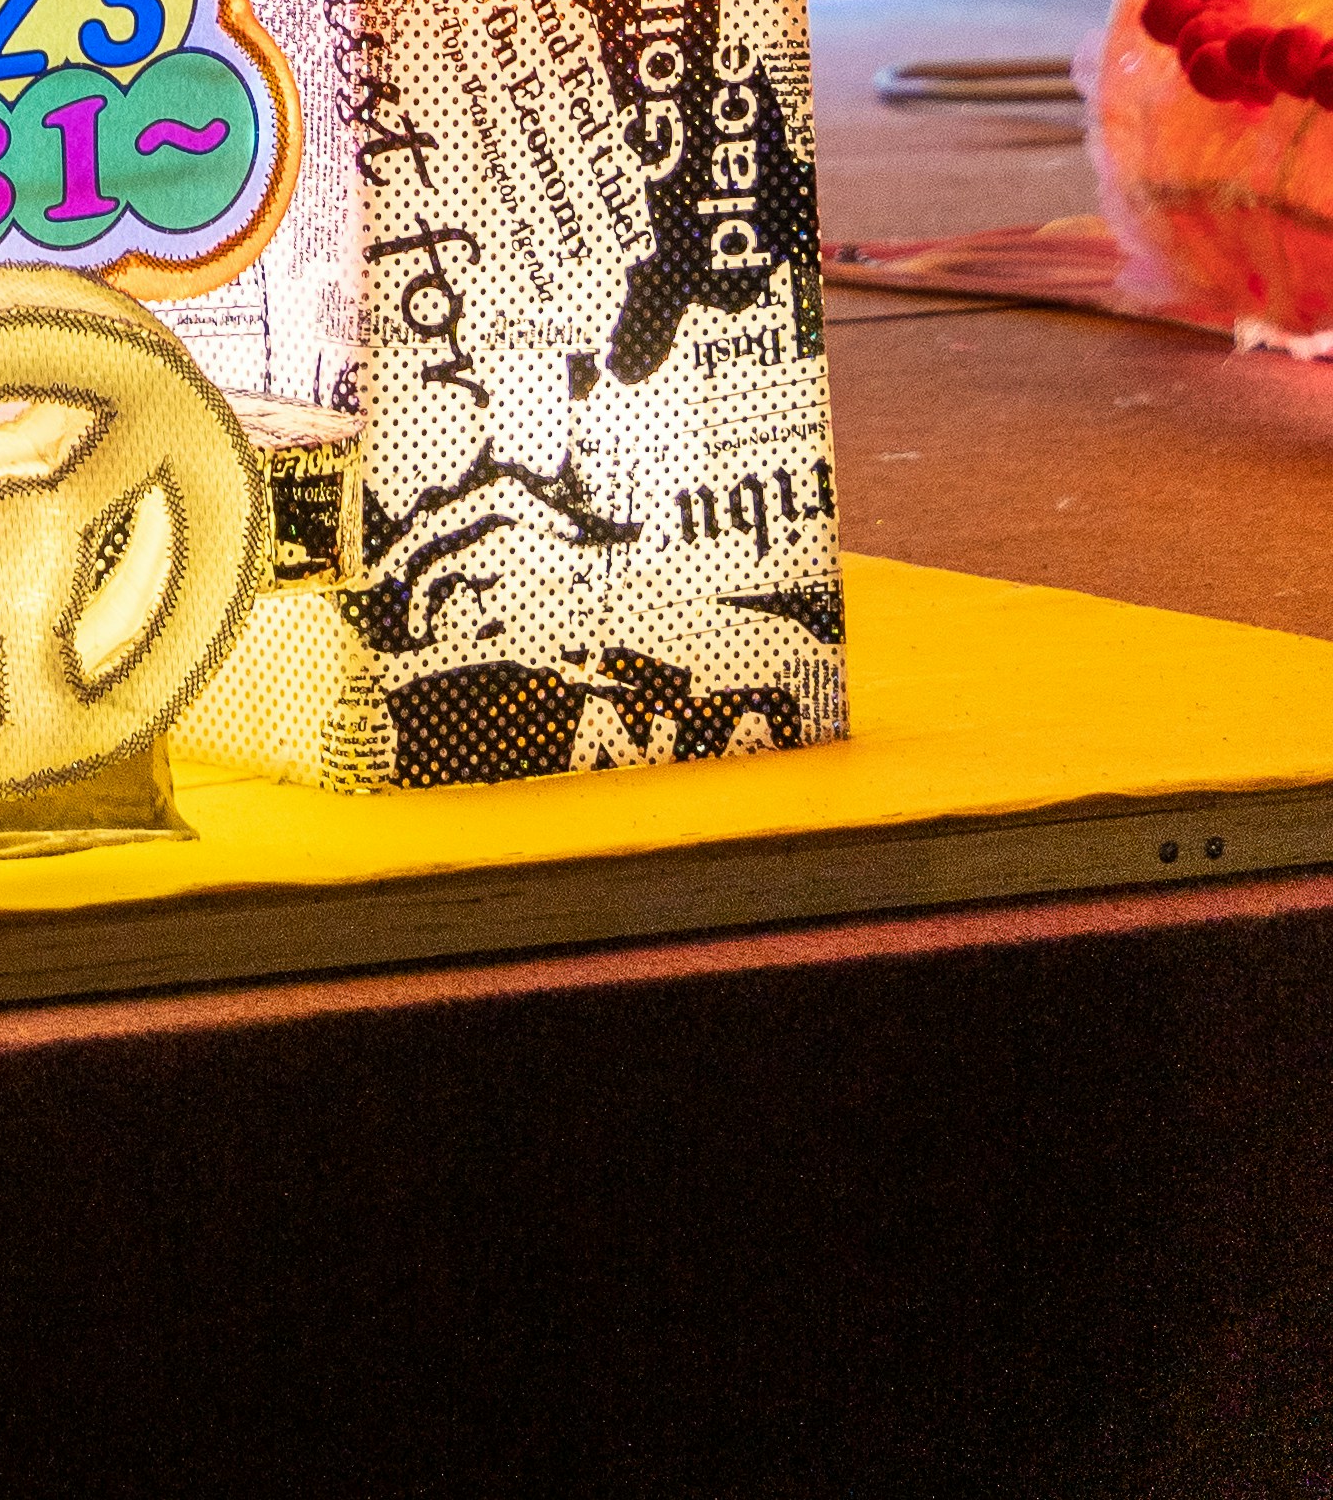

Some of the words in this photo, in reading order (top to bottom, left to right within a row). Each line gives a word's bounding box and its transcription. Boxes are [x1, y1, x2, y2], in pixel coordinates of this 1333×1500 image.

[440, 16, 468, 73] Tops
[461, 74, 520, 215] Washington
[510, 217, 555, 304] Agenda
[485, 5, 520, 72] On
[504, 66, 592, 266] Economy
[558, 57, 611, 146] Fed
[697, 37, 771, 271] place
[363, 213, 491, 409] for
[694, 325, 784, 379] Bush
[743, 418, 831, 449] SHINGTON
